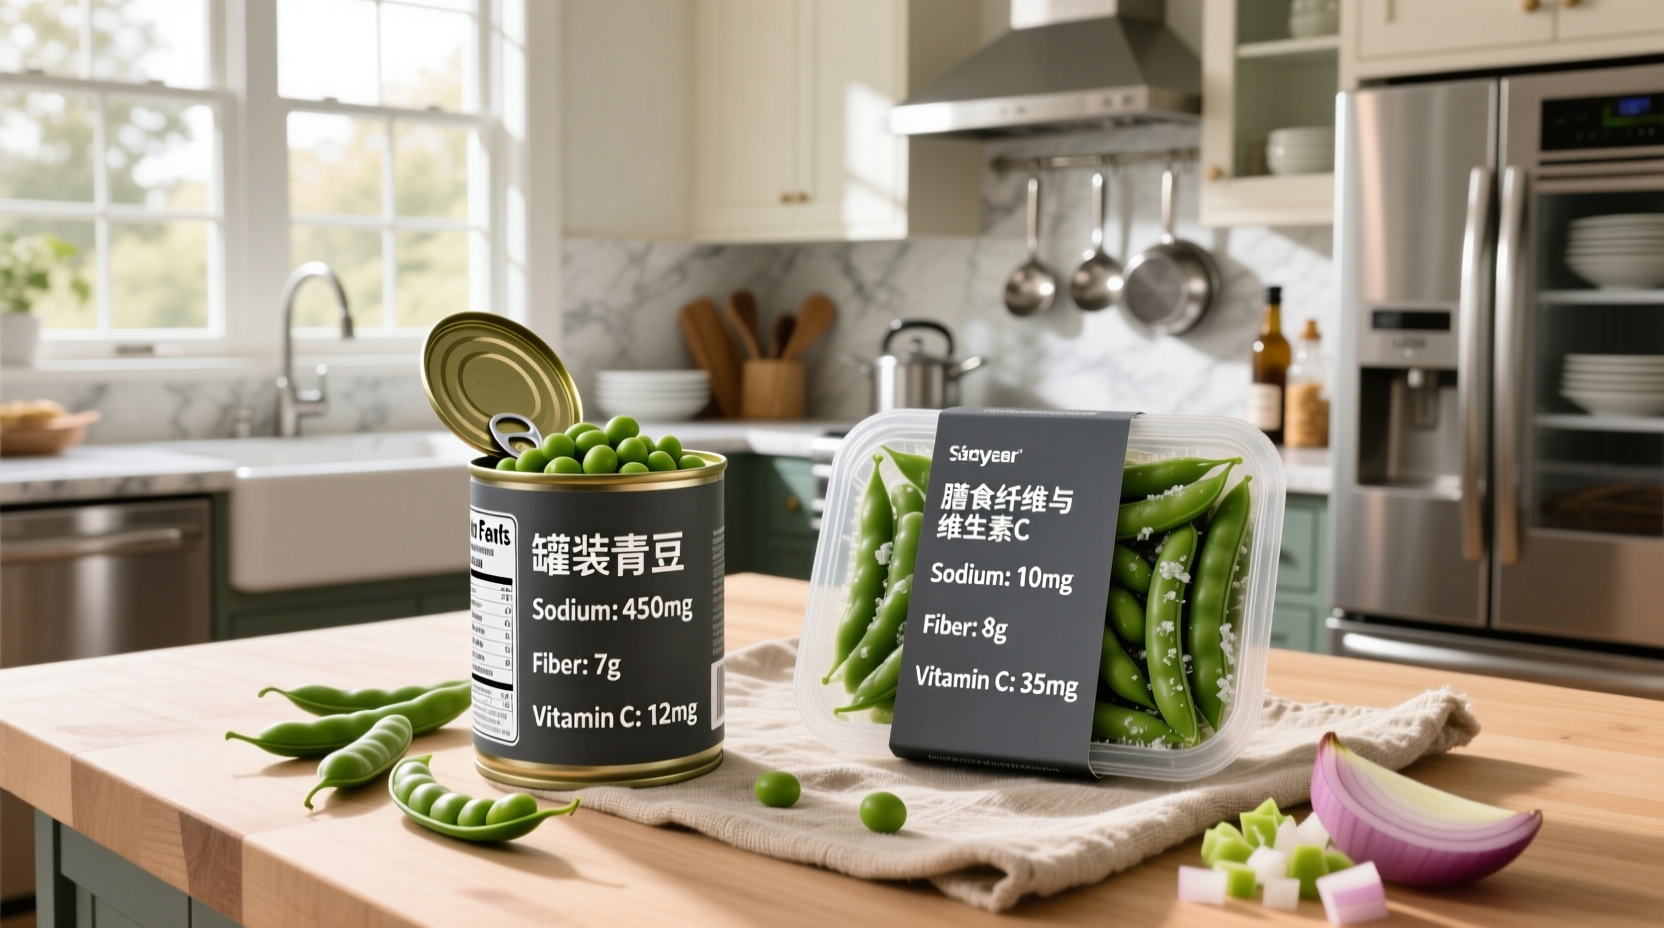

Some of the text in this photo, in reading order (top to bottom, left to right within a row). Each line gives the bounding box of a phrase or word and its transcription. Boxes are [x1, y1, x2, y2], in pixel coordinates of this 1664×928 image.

[941, 483, 1074, 514] 膳食纤维与
[936, 512, 1031, 542] 维生素C
[531, 530, 685, 577] 罐装青豆
[930, 562, 1075, 596] Sodium: 10mg
[532, 595, 694, 623] Sodium: 450mg
[922, 613, 1009, 645] Fiber: 8g
[532, 651, 622, 682] Fiber: 7g
[915, 665, 1080, 703] Vitamin C: 35mg
[532, 704, 614, 729] Vitamin
[619, 706, 642, 728] C:
[647, 702, 699, 726] 12mg
